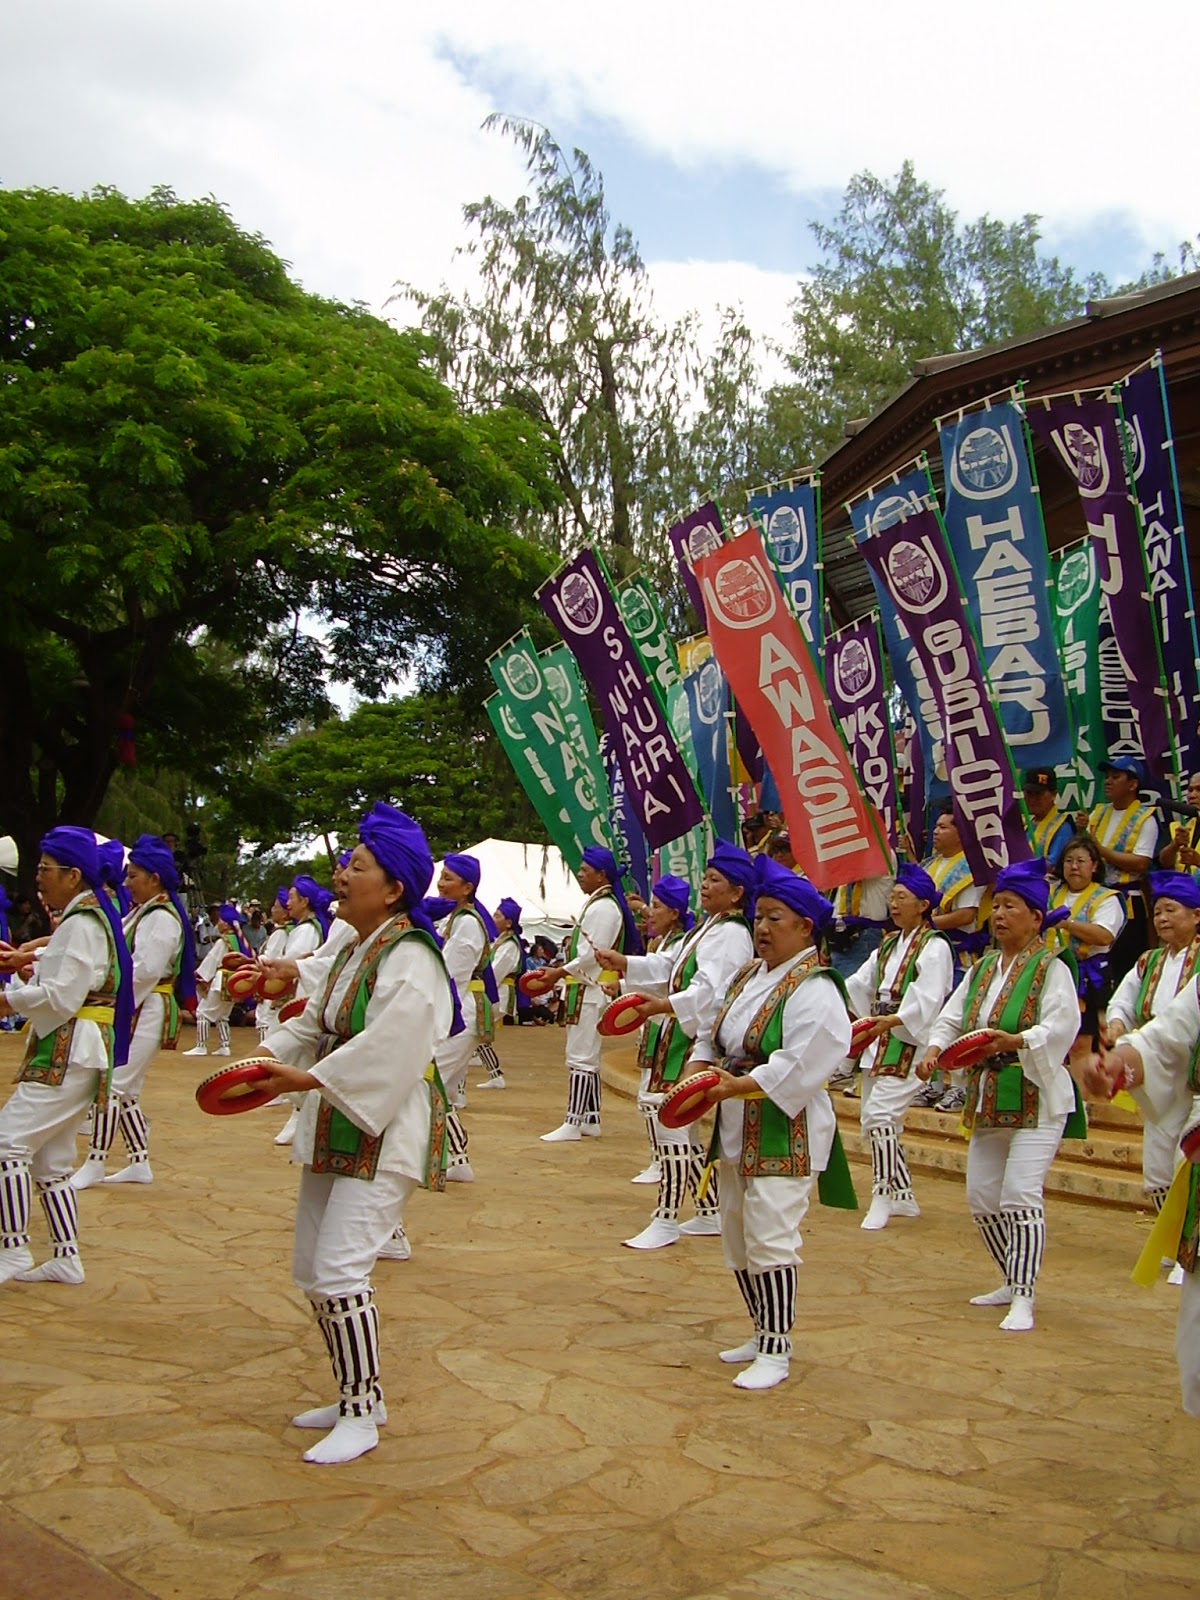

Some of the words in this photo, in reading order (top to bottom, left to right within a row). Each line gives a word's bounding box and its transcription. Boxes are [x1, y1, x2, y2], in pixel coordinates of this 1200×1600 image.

[604, 626, 686, 804] SHURI
[966, 506, 1050, 746] HAEBARU
[608, 672, 672, 825] NAHA
[758, 632, 870, 862] AWASE
[923, 620, 1010, 869] GUSHICHAN
